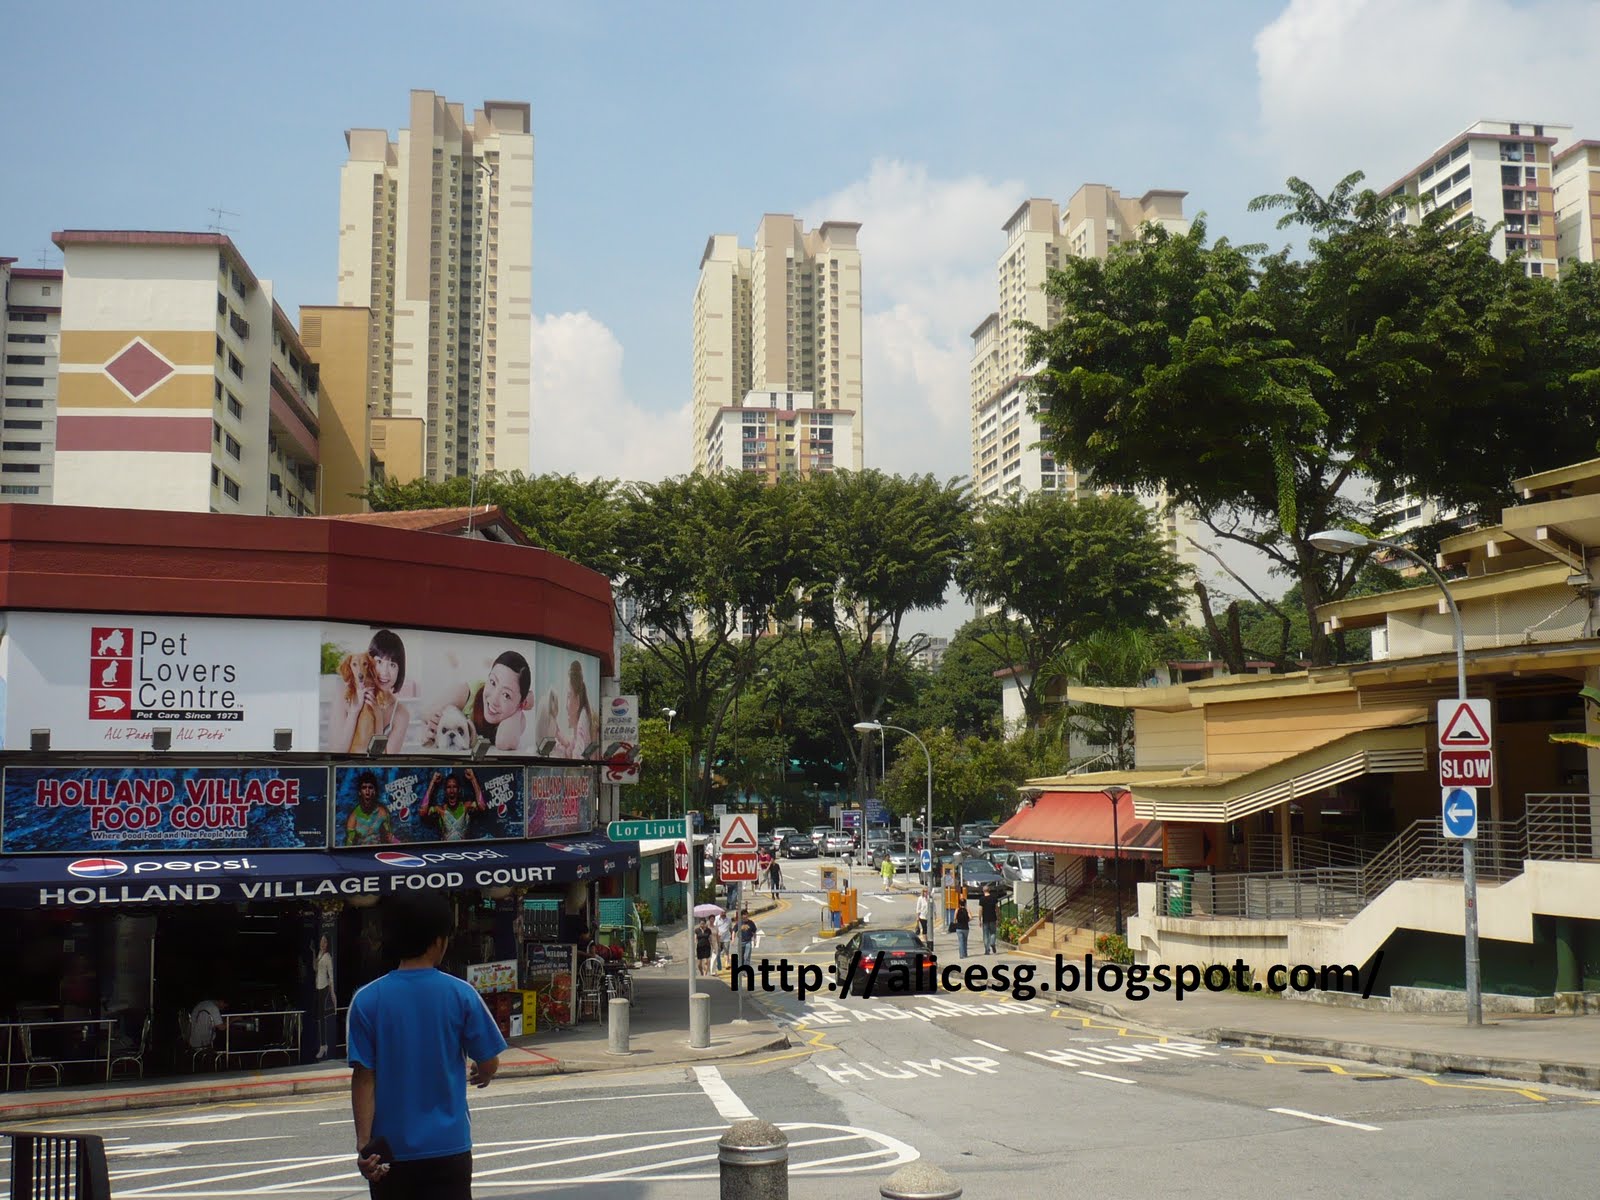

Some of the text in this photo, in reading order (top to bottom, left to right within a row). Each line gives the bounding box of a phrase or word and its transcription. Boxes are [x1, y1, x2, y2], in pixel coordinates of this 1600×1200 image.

[140, 631, 187, 656] Pet
[139, 657, 236, 682] Lovers
[138, 683, 236, 709] Centre
[136, 711, 238, 719] Pet Care Since 1973
[104, 727, 122, 740] All
[176, 727, 194, 740] All
[197, 727, 224, 740] Pets
[1442, 759, 1490, 779] SLOW
[385, 775, 418, 792] REFRESH
[484, 773, 514, 790] REFRESH
[36, 779, 299, 807] HOLLAND VILLAGE
[391, 785, 413, 800] YOUR
[487, 791, 514, 809] WORLD
[489, 784, 510, 798] YOUR
[387, 793, 418, 812] WORLD
[90, 805, 249, 830] FOOD COURT
[92, 832, 122, 840] Where
[122, 832, 143, 840] Good
[143, 831, 162, 840] Food
[198, 831, 224, 840] People
[224, 830, 248, 839] Meet
[616, 822, 683, 837] Lor Liput
[722, 860, 756, 874] SLOW
[39, 867, 556, 905] HOLLAND VILLAGE FOOD COURT
[1024, 1043, 1220, 1067] HUMP
[816, 1056, 1000, 1083] HUMP
